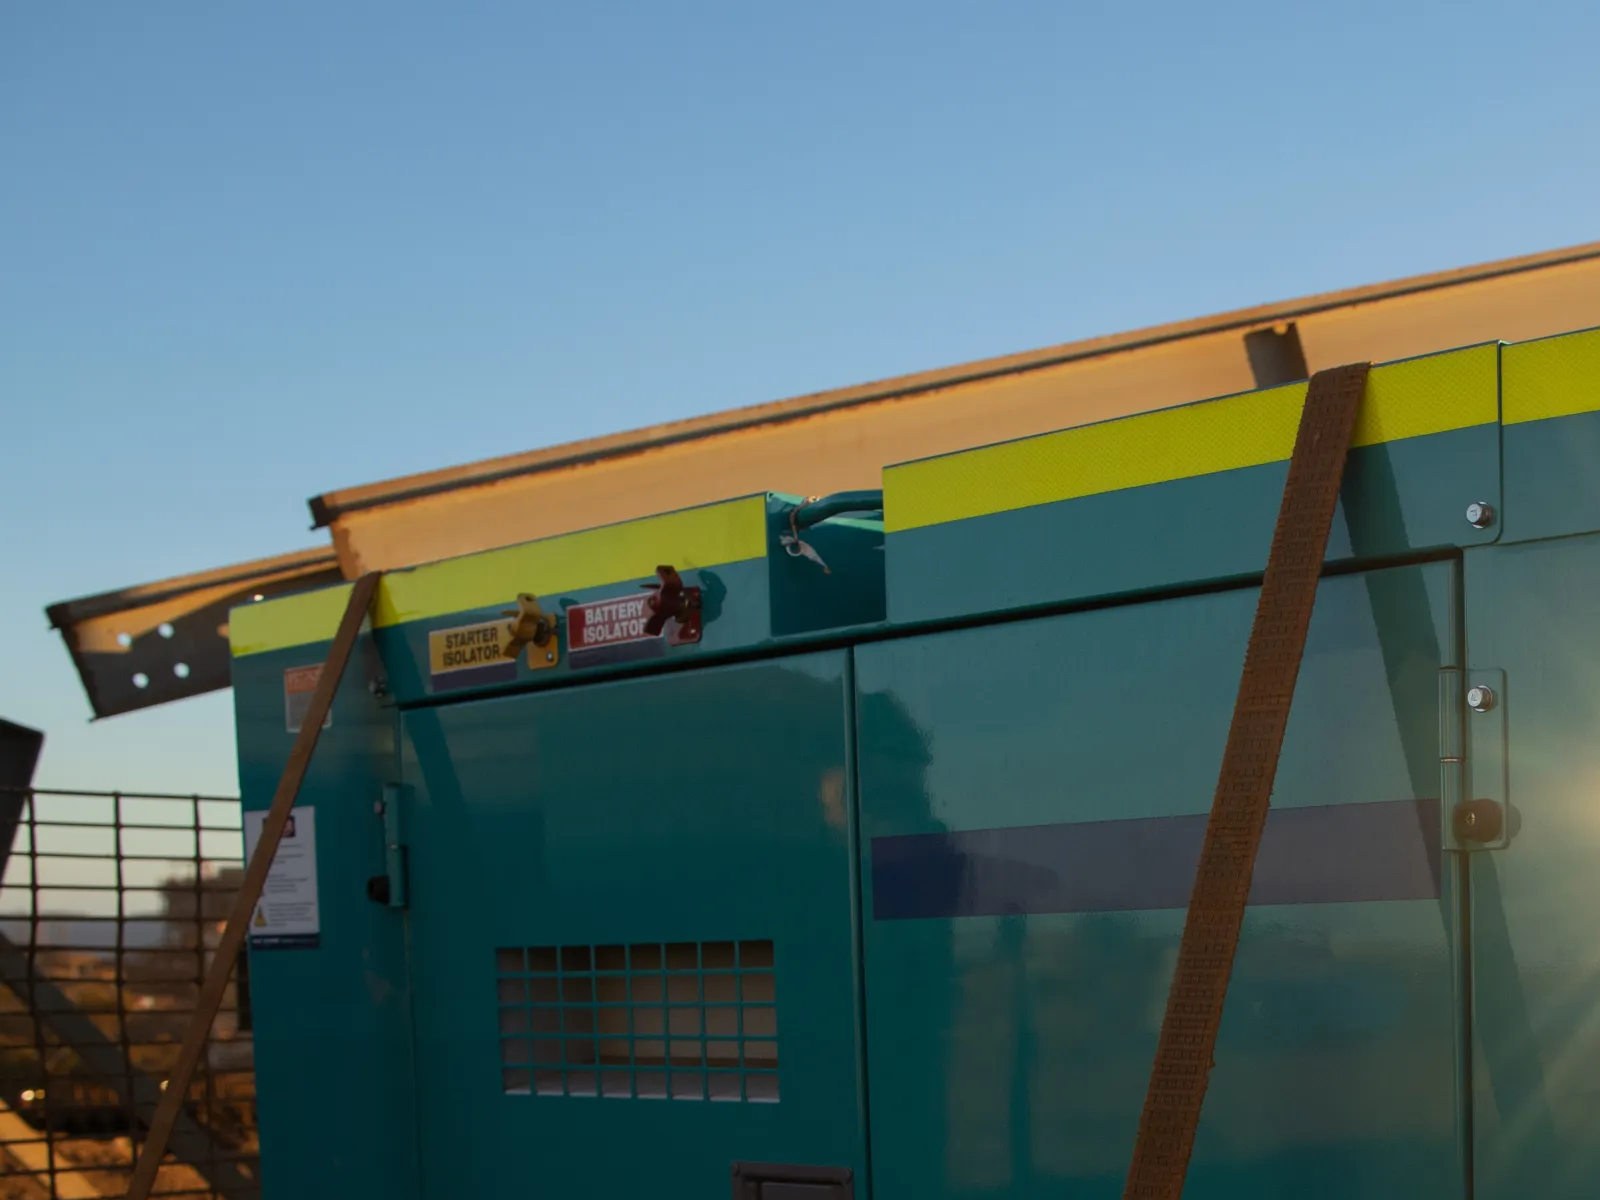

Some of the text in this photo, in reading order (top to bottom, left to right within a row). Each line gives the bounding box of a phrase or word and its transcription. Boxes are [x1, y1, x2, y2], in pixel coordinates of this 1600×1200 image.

[585, 599, 644, 625] BATTERY
[446, 627, 497, 649] STARTER
[443, 644, 500, 666] ISOLATOR
